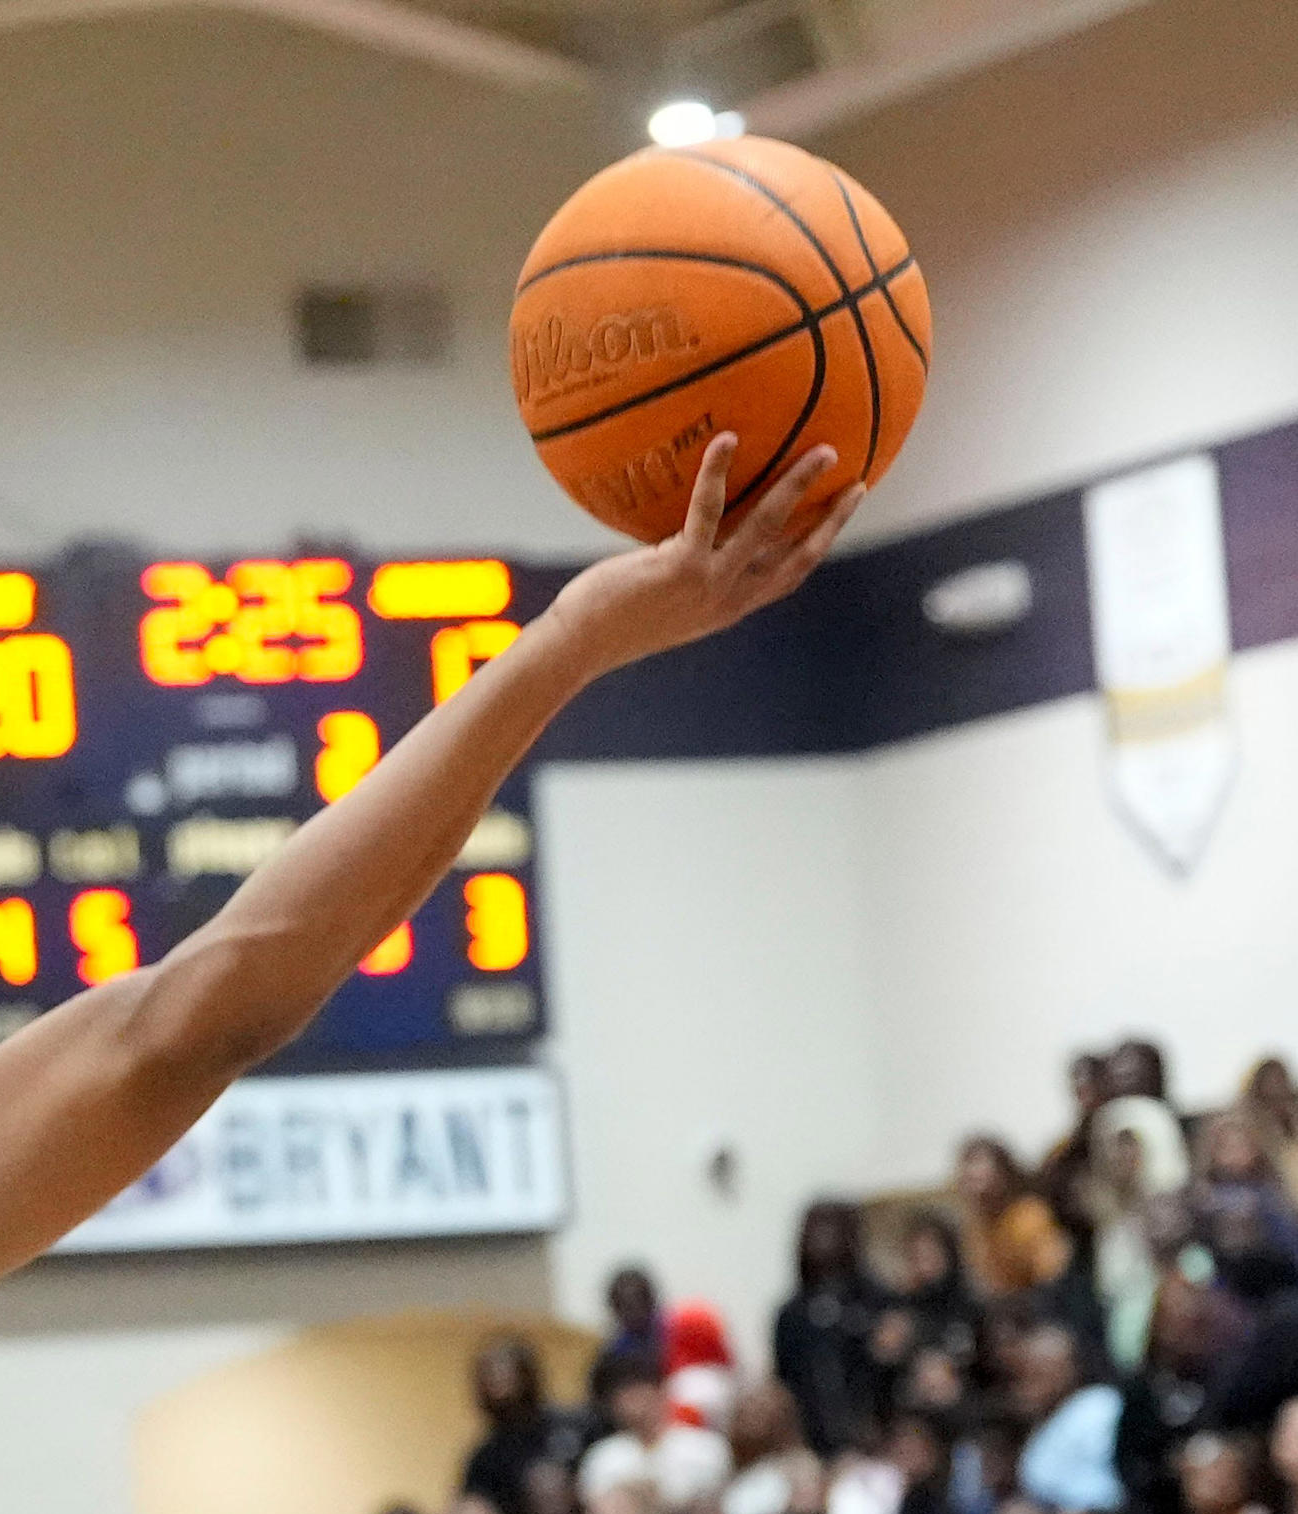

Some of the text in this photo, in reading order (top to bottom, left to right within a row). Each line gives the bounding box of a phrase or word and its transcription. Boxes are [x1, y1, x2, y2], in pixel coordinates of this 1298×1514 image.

[140, 556, 365, 686] 2:25
[69, 888, 140, 986] 5
[463, 872, 529, 971] 3
